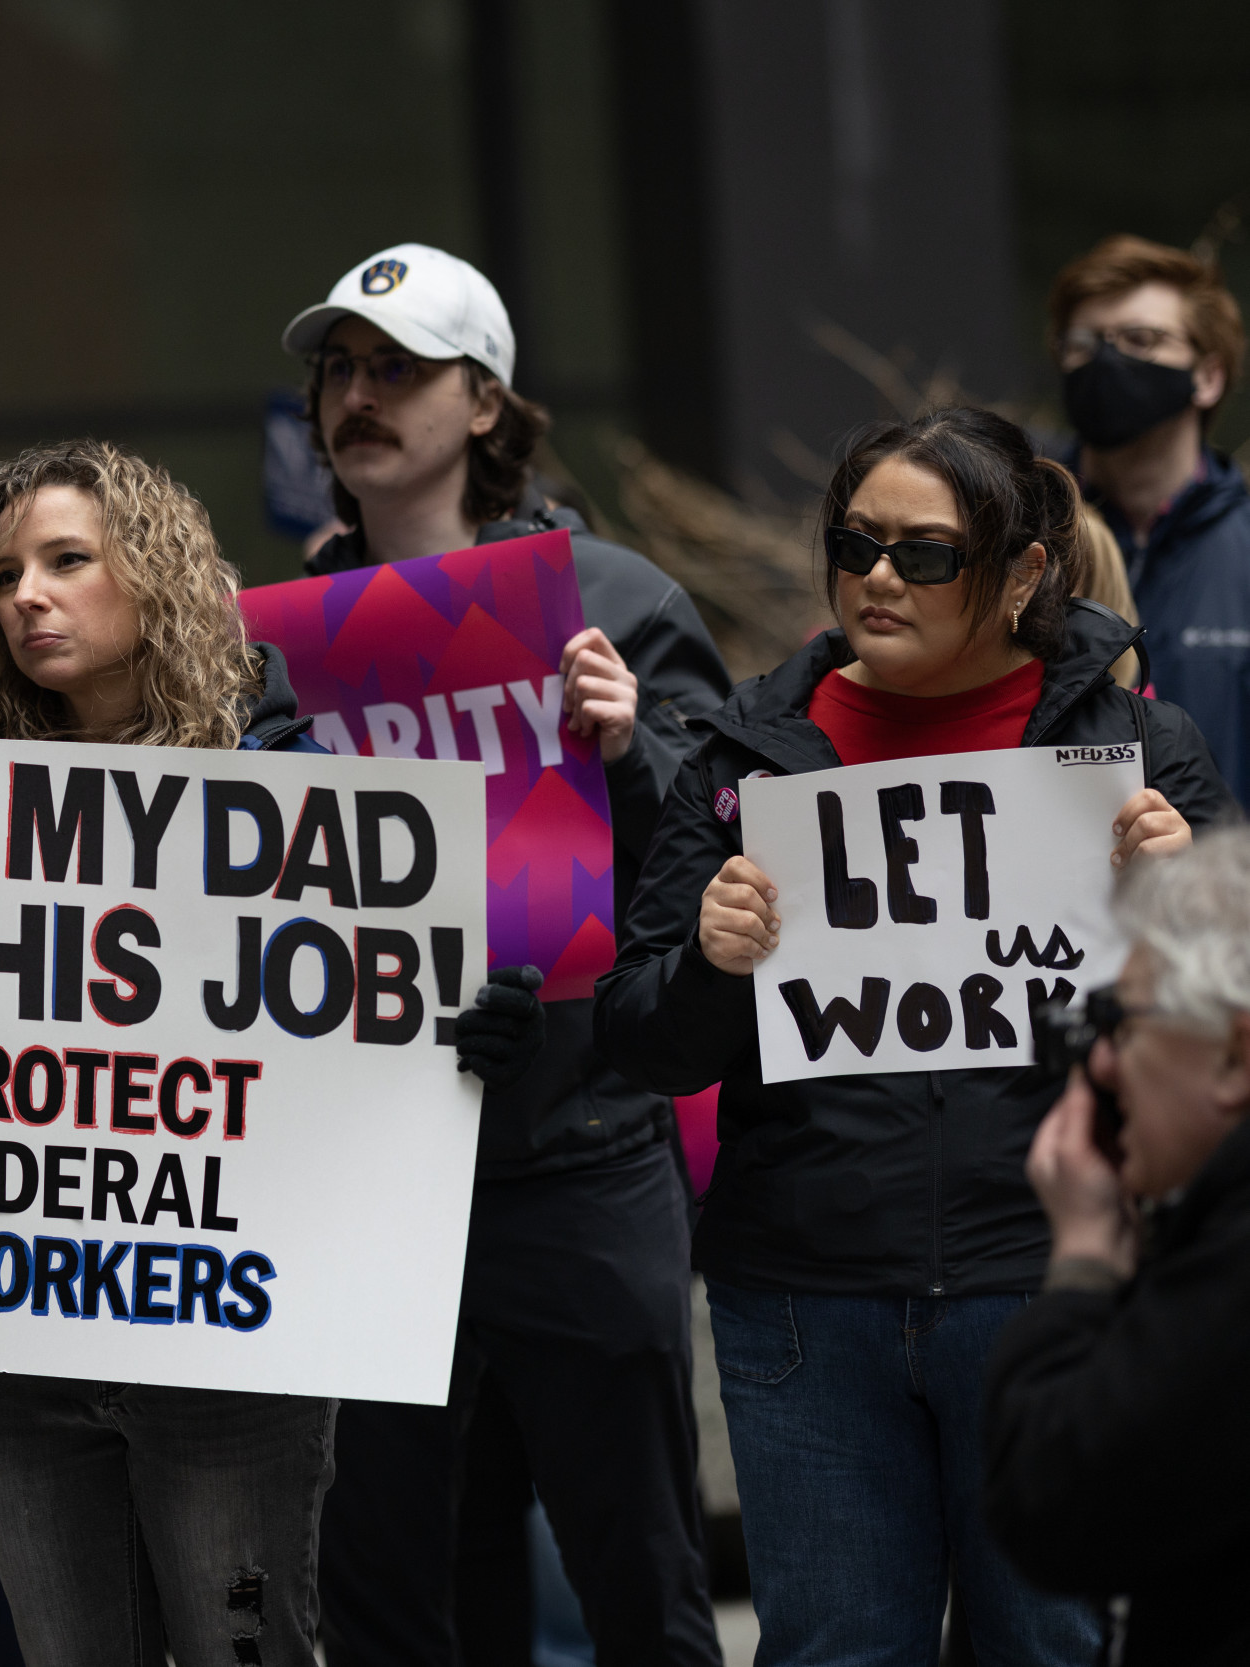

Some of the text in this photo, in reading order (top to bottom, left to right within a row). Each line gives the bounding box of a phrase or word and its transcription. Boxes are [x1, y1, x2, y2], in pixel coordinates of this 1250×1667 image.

[5, 761, 190, 890] MY
[201, 778, 438, 909] DAD
[714, 790, 730, 816] CFPB
[721, 797, 736, 822] UNION
[817, 781, 996, 929] LET
[200, 915, 465, 1047] JOB!
